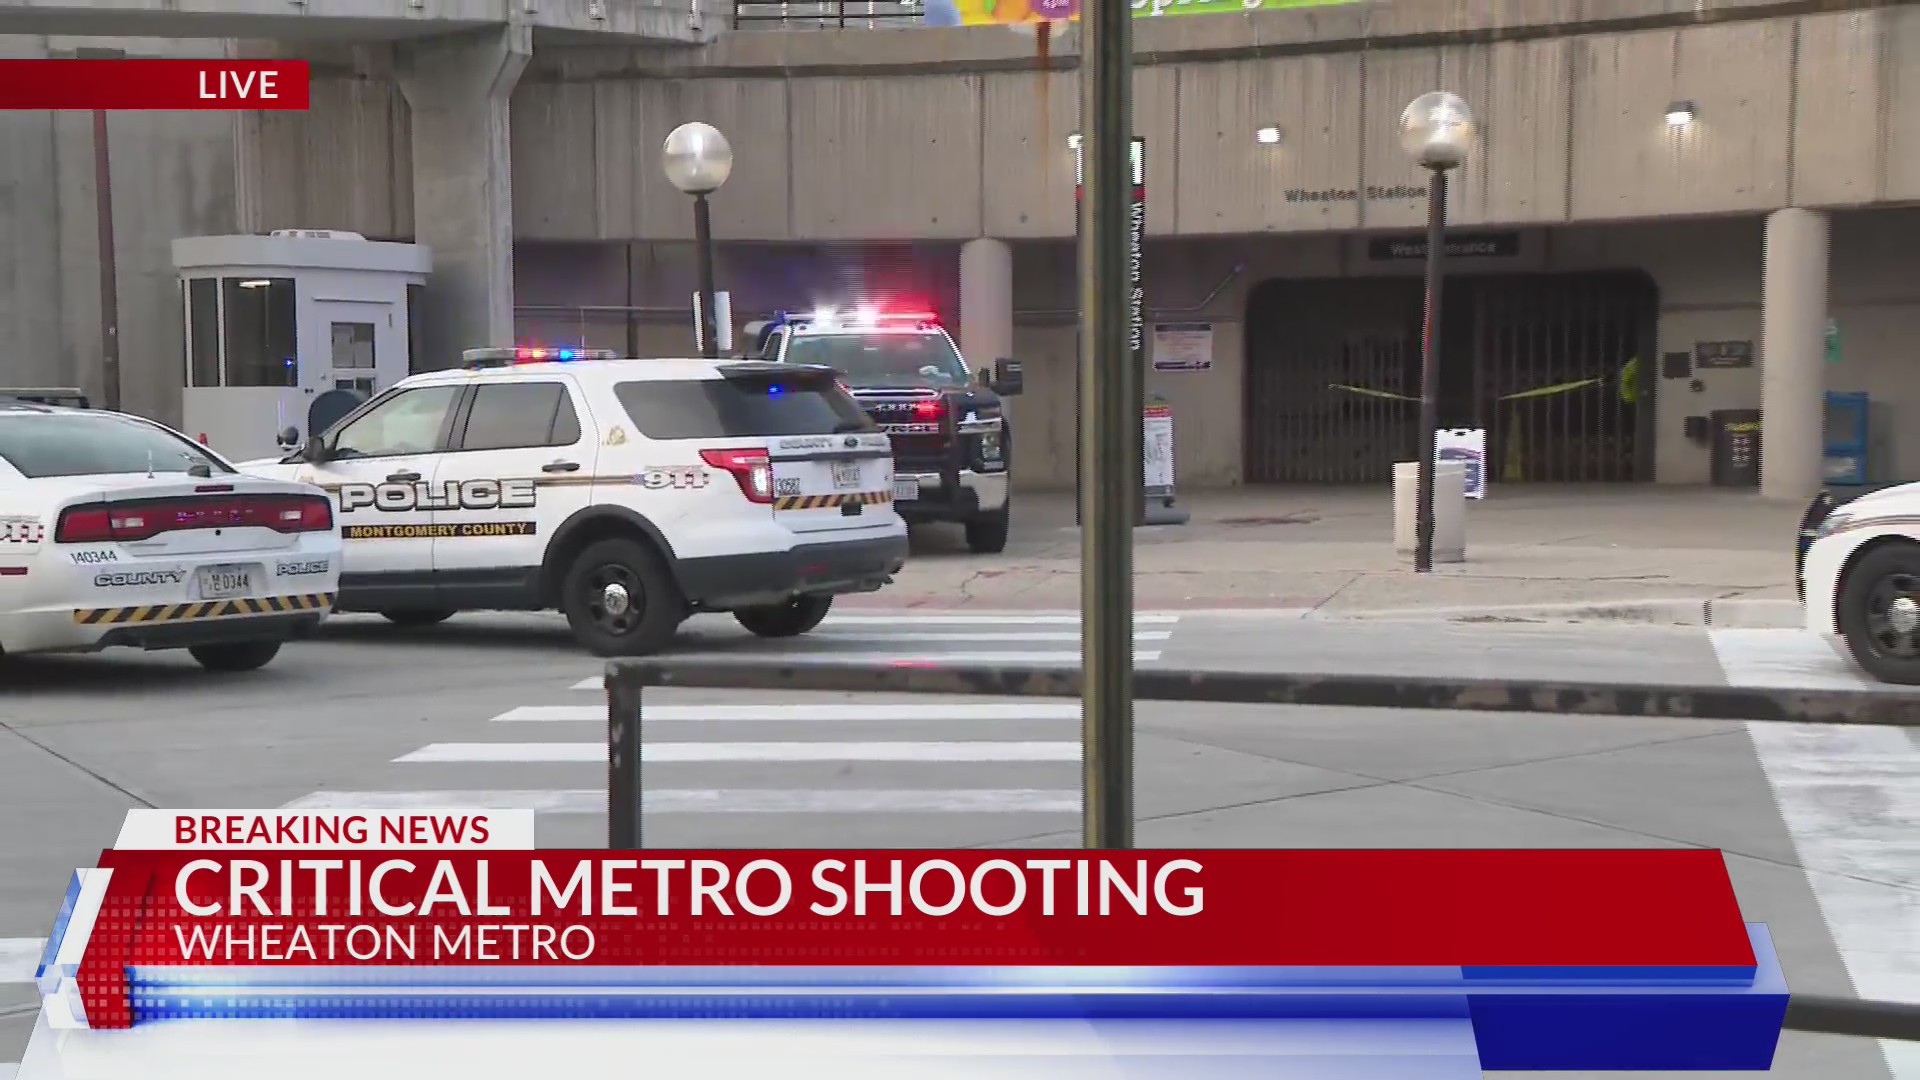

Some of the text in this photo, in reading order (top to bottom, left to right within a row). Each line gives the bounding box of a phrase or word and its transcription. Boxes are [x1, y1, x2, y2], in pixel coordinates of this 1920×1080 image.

[1283, 186, 1427, 202] Wheaton Station
[1130, 202, 1144, 351] Wheaton Station
[644, 469, 710, 490] 911
[339, 479, 537, 513] POLICE
[350, 522, 528, 538] MONTGOMERY COUNTY
[70, 550, 118, 565] 140344
[276, 559, 330, 576] POLICE
[94, 568, 188, 588] COUNTY
[223, 572, 250, 591] 0344
